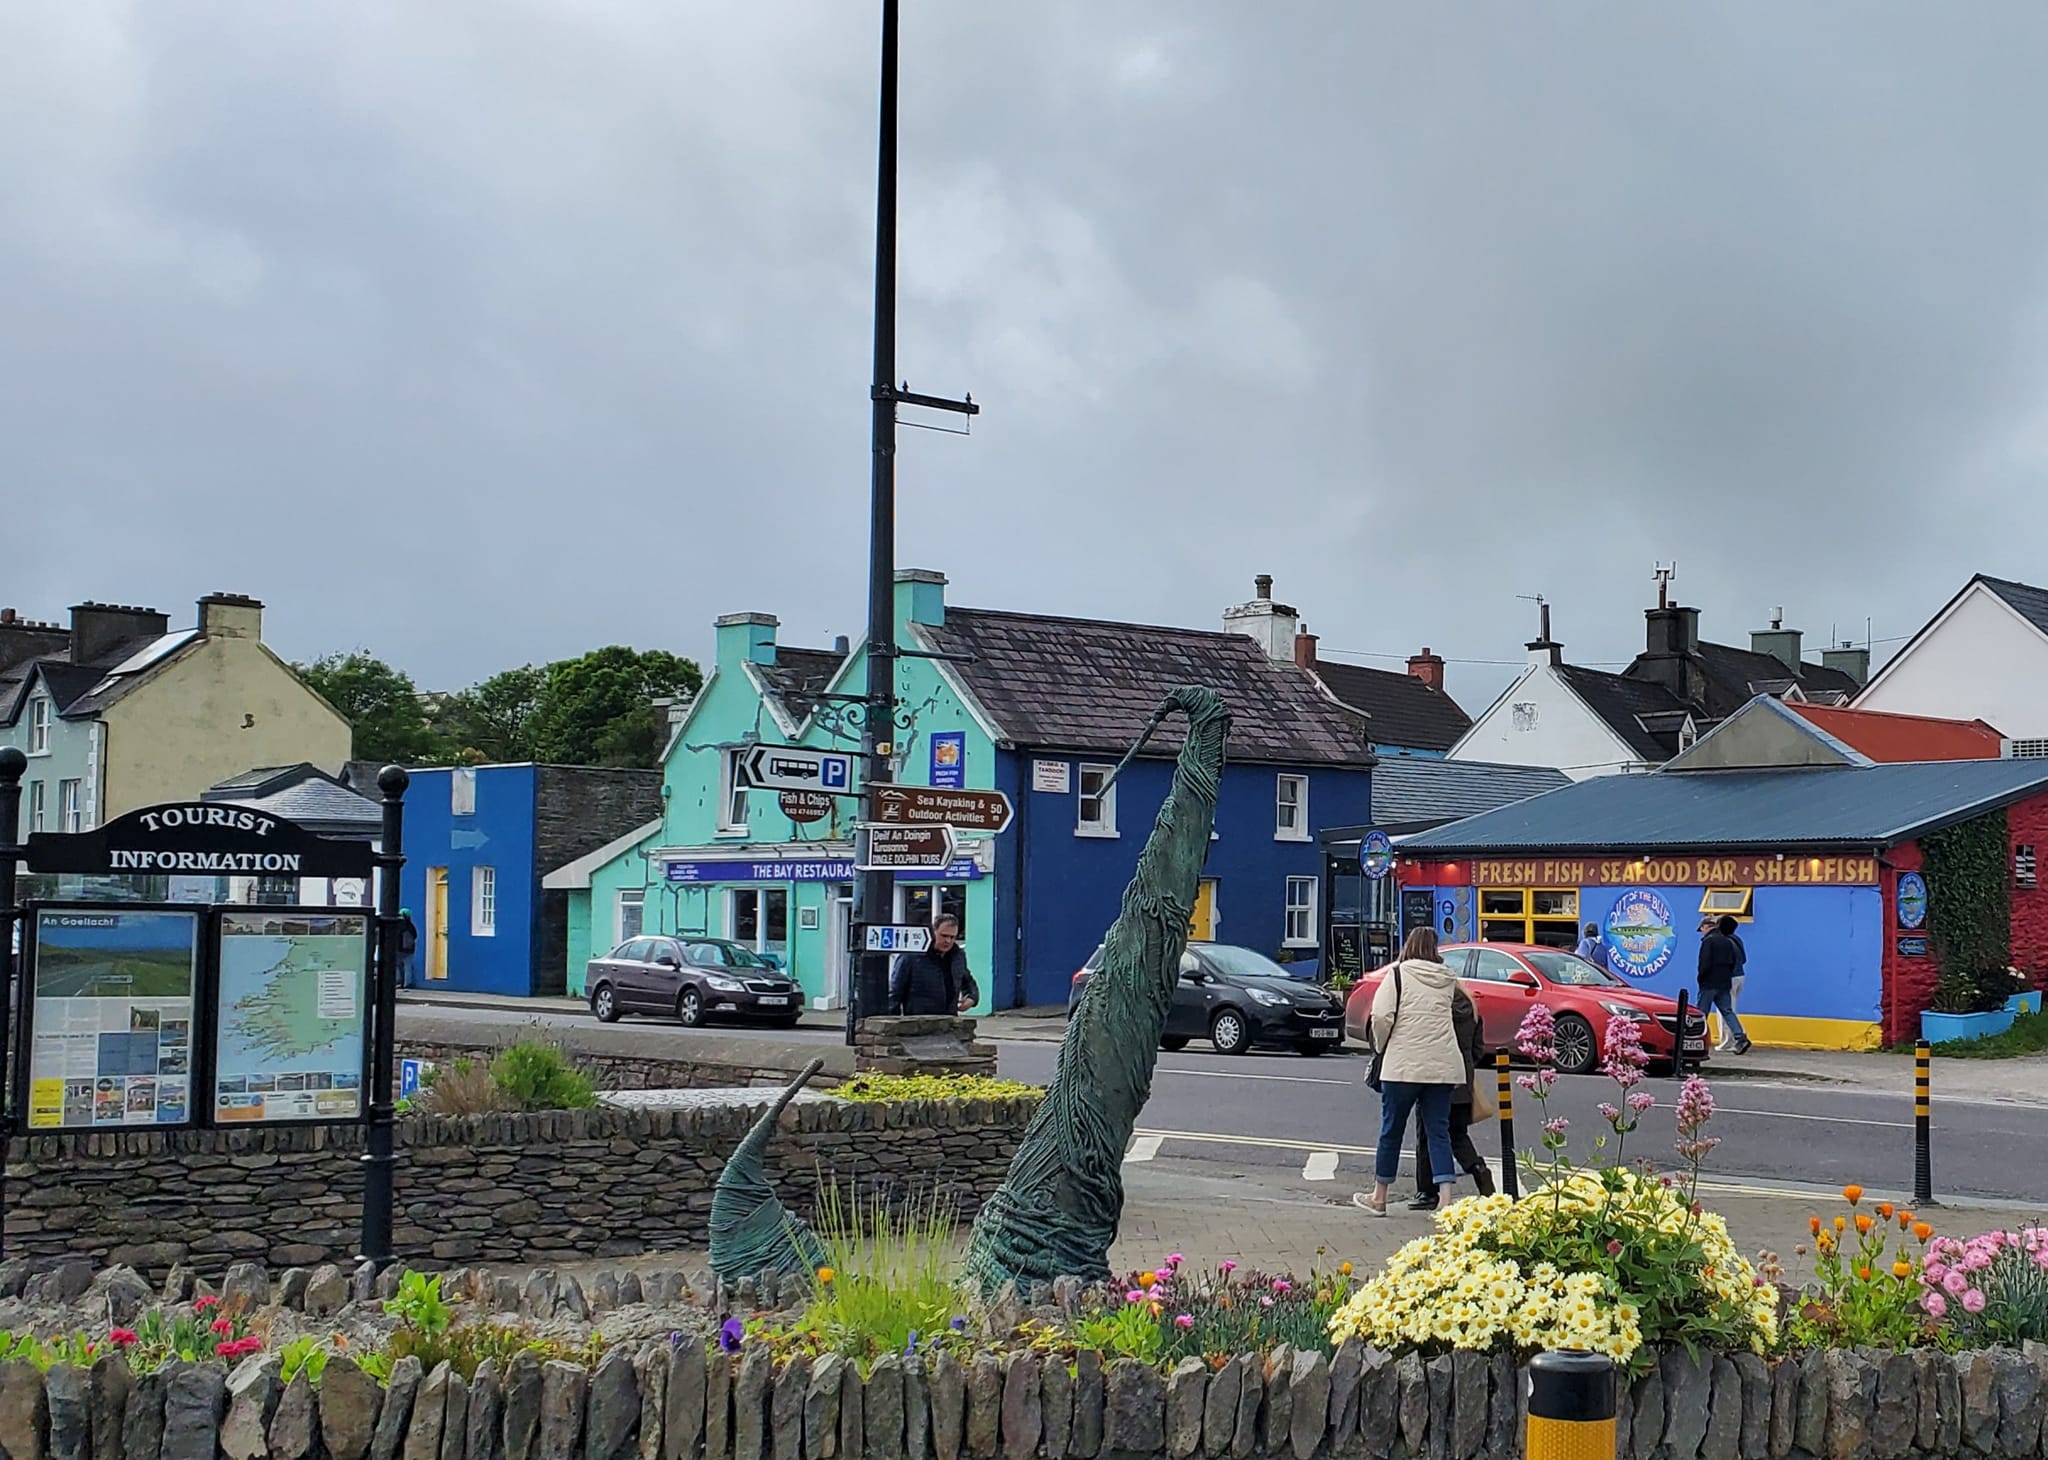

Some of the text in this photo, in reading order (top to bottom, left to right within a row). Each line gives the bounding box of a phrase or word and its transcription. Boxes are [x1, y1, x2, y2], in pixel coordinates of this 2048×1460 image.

[827, 761, 843, 784] P
[780, 791, 830, 809] Fish & Chips
[917, 795, 985, 810] Sea Kayaking &
[908, 808, 985, 823] Outdoor Activities
[990, 803, 1003, 814] 50
[140, 807, 275, 836] TOURIST
[892, 830, 902, 840] An
[903, 829, 931, 843] Daingin
[109, 850, 301, 871] INFORMATION
[872, 854, 893, 865] DINGLE
[894, 854, 919, 865] DOLPHIN
[920, 854, 940, 864] TOURS
[752, 863, 855, 878] THE BAY RESTAURA
[1479, 858, 1874, 884] FRESH FISH SEAFOOD BAR SHELLFISH
[1610, 895, 1628, 926] OUT
[1629, 891, 1638, 901] OF
[1639, 891, 1652, 902] THE
[1651, 895, 1670, 926] BLUE
[42, 917, 57, 925] An
[1608, 944, 1671, 976] RESTAURANT
